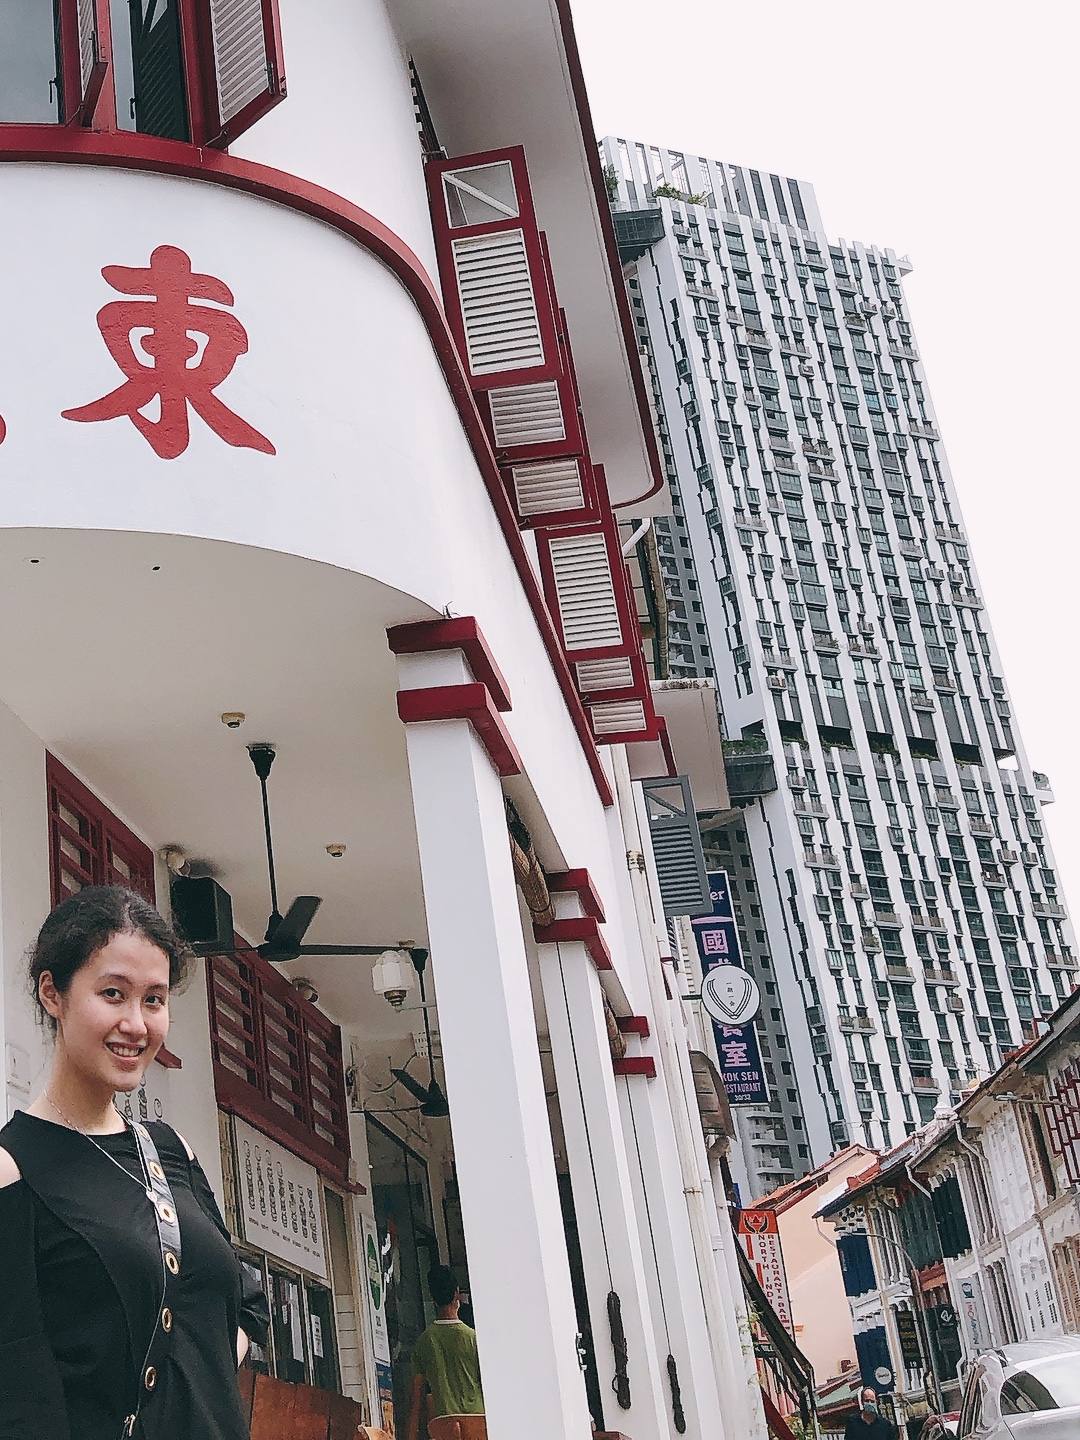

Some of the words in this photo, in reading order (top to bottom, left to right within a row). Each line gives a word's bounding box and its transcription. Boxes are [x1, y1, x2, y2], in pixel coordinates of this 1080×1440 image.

[721, 1072, 740, 1082] KOK
[741, 1071, 759, 1081] SEN
[758, 1234, 770, 1270] NORTH
[767, 1234, 783, 1294] RESTAURANT
